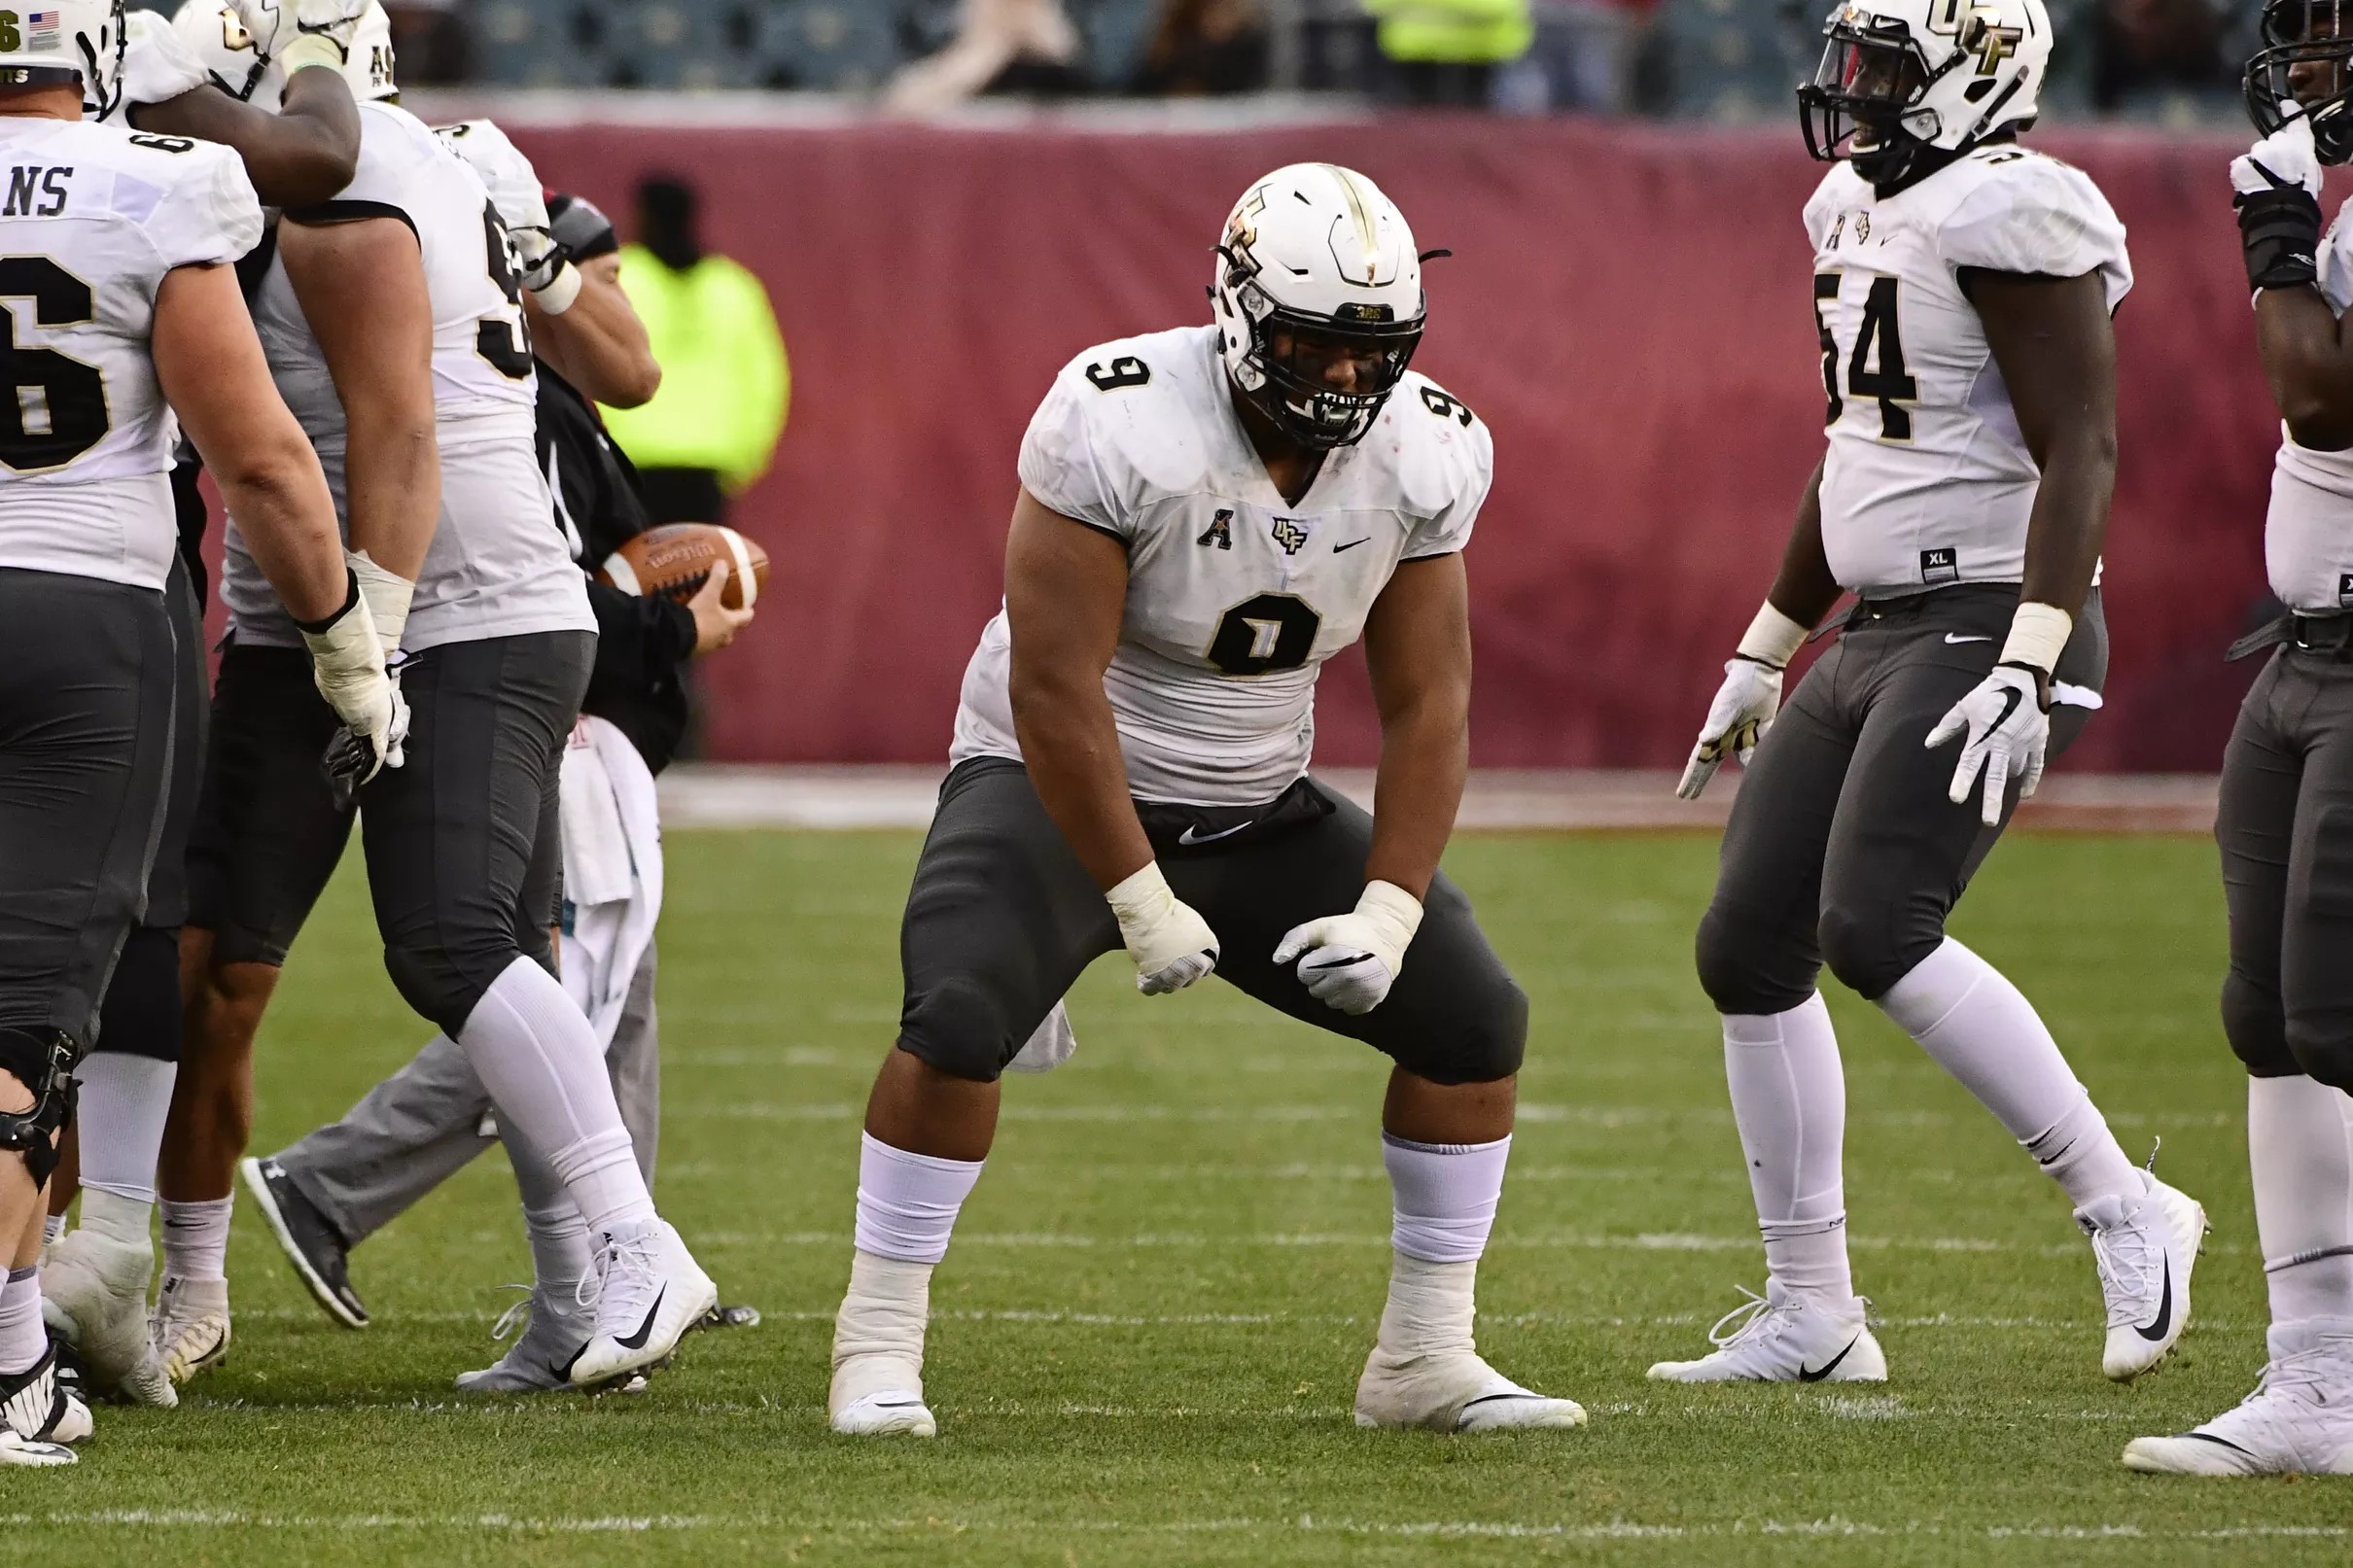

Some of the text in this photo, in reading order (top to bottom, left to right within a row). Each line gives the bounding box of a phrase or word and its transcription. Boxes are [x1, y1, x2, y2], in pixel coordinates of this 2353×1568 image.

[3, 166, 74, 216] NS
[1084, 356, 1152, 395] 9
[1419, 385, 1473, 429] 9
[1272, 516, 1308, 555] UCF
[1928, 552, 1949, 565] XL
